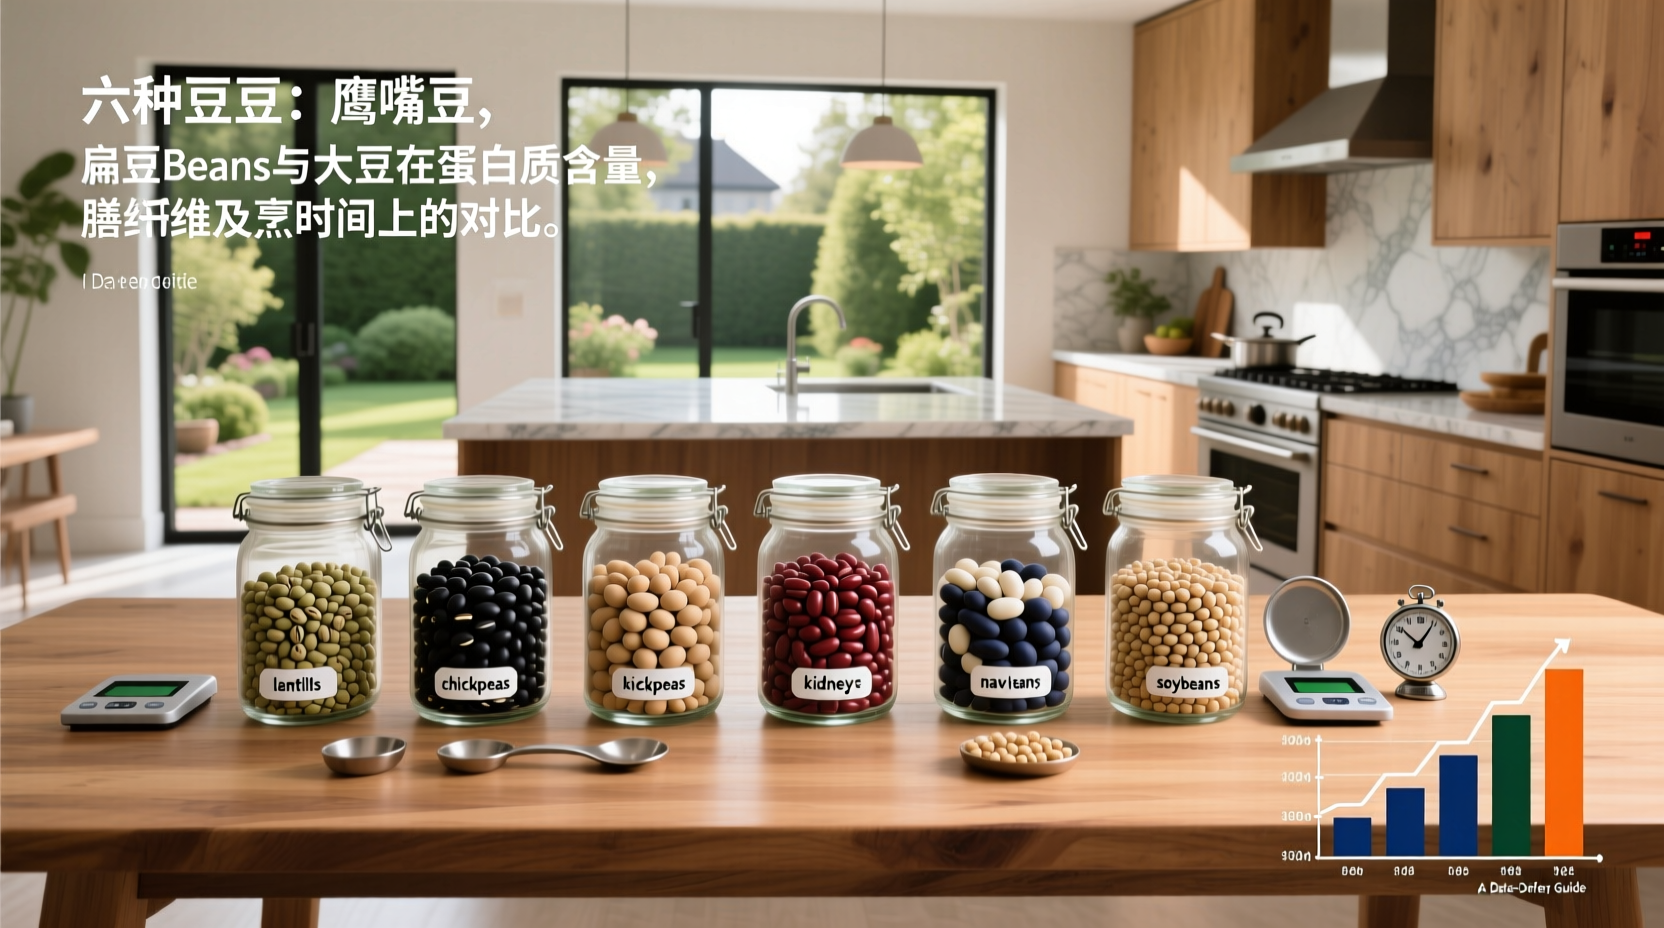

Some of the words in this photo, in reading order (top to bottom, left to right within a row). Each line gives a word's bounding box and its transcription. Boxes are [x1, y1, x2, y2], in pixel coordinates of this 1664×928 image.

[441, 675, 510, 695] chickpeas
[623, 675, 686, 695] kickpeas
[1156, 675, 1221, 694] soybeans
